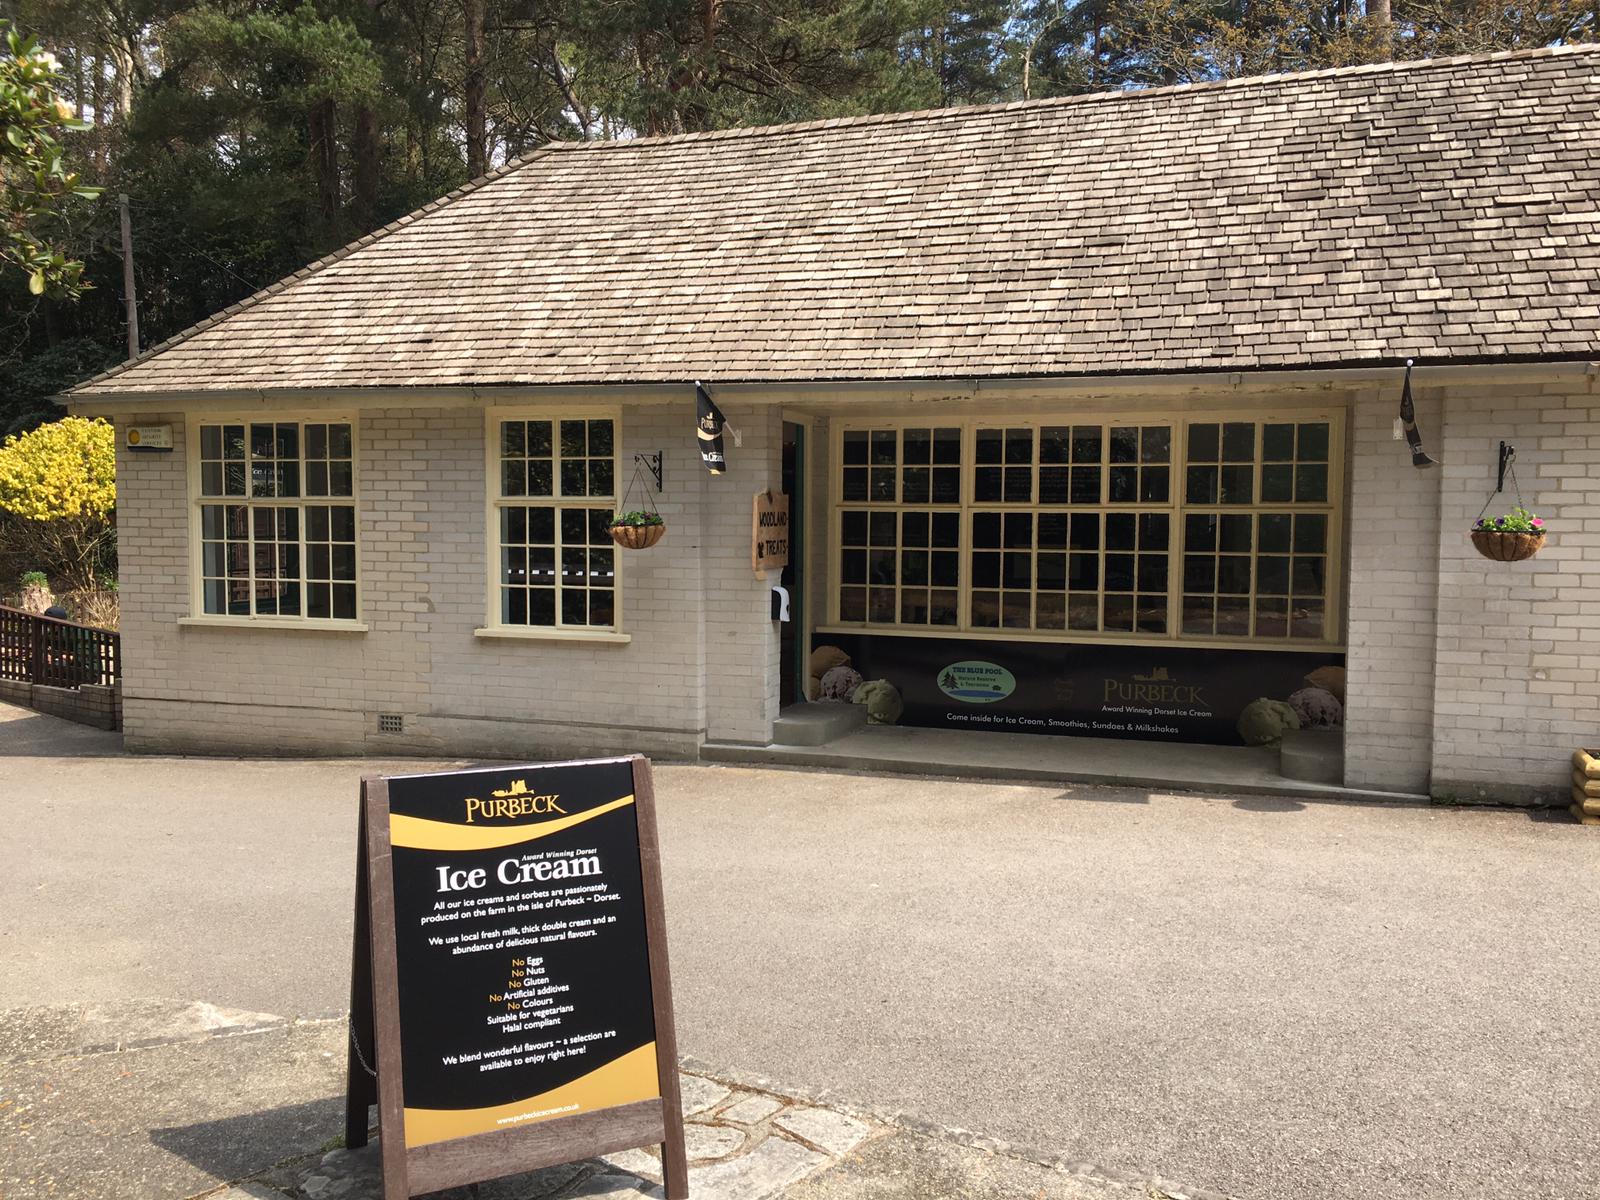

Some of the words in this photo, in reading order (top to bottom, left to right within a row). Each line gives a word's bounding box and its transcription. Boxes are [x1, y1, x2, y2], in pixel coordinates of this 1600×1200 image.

[759, 511, 787, 527] WOODLAND
[765, 539, 787, 556] TREATS
[1103, 678, 1208, 706] PURBECK
[1101, 705, 1124, 713] Award
[1125, 706, 1153, 716] Winning
[1189, 709, 1212, 717] Cream
[946, 712, 969, 721] Come
[970, 714, 992, 722] inside
[993, 715, 1004, 723] for
[1005, 716, 1017, 724] Ice
[1018, 717, 1046, 726] Cream,
[1048, 718, 1090, 729] Smoothies,
[1091, 721, 1126, 730] Sundaes
[1126, 723, 1134, 731] &
[1135, 724, 1179, 733] Milkshakes
[464, 794, 568, 823] PURBECK
[521, 852, 544, 861] Award
[546, 850, 574, 859] Winning
[576, 848, 597, 856] Dorset
[435, 866, 486, 892] Ice
[497, 856, 603, 885] Cream
[433, 901, 445, 910] All
[447, 901, 462, 909] our
[463, 899, 475, 907] ice
[476, 896, 504, 906] creams
[505, 892, 520, 902] and
[521, 890, 550, 900] sorbets
[551, 889, 563, 897] are
[564, 882, 608, 897] passionately
[420, 911, 459, 926] produced
[460, 911, 472, 919] on
[473, 908, 487, 917] the
[488, 906, 506, 915] farm
[507, 905, 515, 913] in
[516, 903, 530, 912] the
[531, 901, 544, 910] isle
[545, 899, 554, 908] of
[554, 896, 585, 907] Purbeck
[593, 893, 621, 903] Dorset.
[428, 936, 444, 946] We
[445, 936, 459, 944] use
[460, 931, 480, 942] local
[480, 929, 501, 939] fresh
[502, 926, 521, 937] milk,
[521, 924, 541, 934] thick
[541, 920, 567, 931] double
[568, 919, 592, 928] cream
[593, 915, 606, 925] and
[452, 943, 494, 955] abundance
[495, 939, 504, 949] of
[505, 937, 539, 948] delicious
[540, 931, 566, 943] natural
[567, 929, 598, 939] flavours.
[512, 958, 525, 967] No
[526, 956, 544, 967] Eggs
[511, 969, 525, 978] No
[526, 966, 546, 976] Nuts
[508, 980, 522, 989] No
[523, 977, 550, 987] Gluten
[489, 994, 503, 1003] No
[503, 988, 536, 1001] Artificial
[537, 984, 570, 996] additives
[507, 1002, 521, 1010] No
[522, 997, 554, 1008] Colours
[487, 1012, 518, 1025] Suitable
[518, 1011, 531, 1020] for
[532, 1005, 574, 1019] vegetarians
[502, 1022, 522, 1033] Halal
[523, 1017, 561, 1030] compliant
[442, 1056, 458, 1065] We
[459, 1051, 482, 1063] blend
[483, 1044, 523, 1059] wonderful
[524, 1040, 554, 1052] flavours
[569, 1032, 603, 1044] selection
[604, 1030, 616, 1038] are
[479, 1058, 512, 1072] available
[513, 1058, 523, 1066] to
[524, 1054, 546, 1064] enjoy
[547, 1049, 566, 1061] right
[566, 1045, 586, 1056] here!
